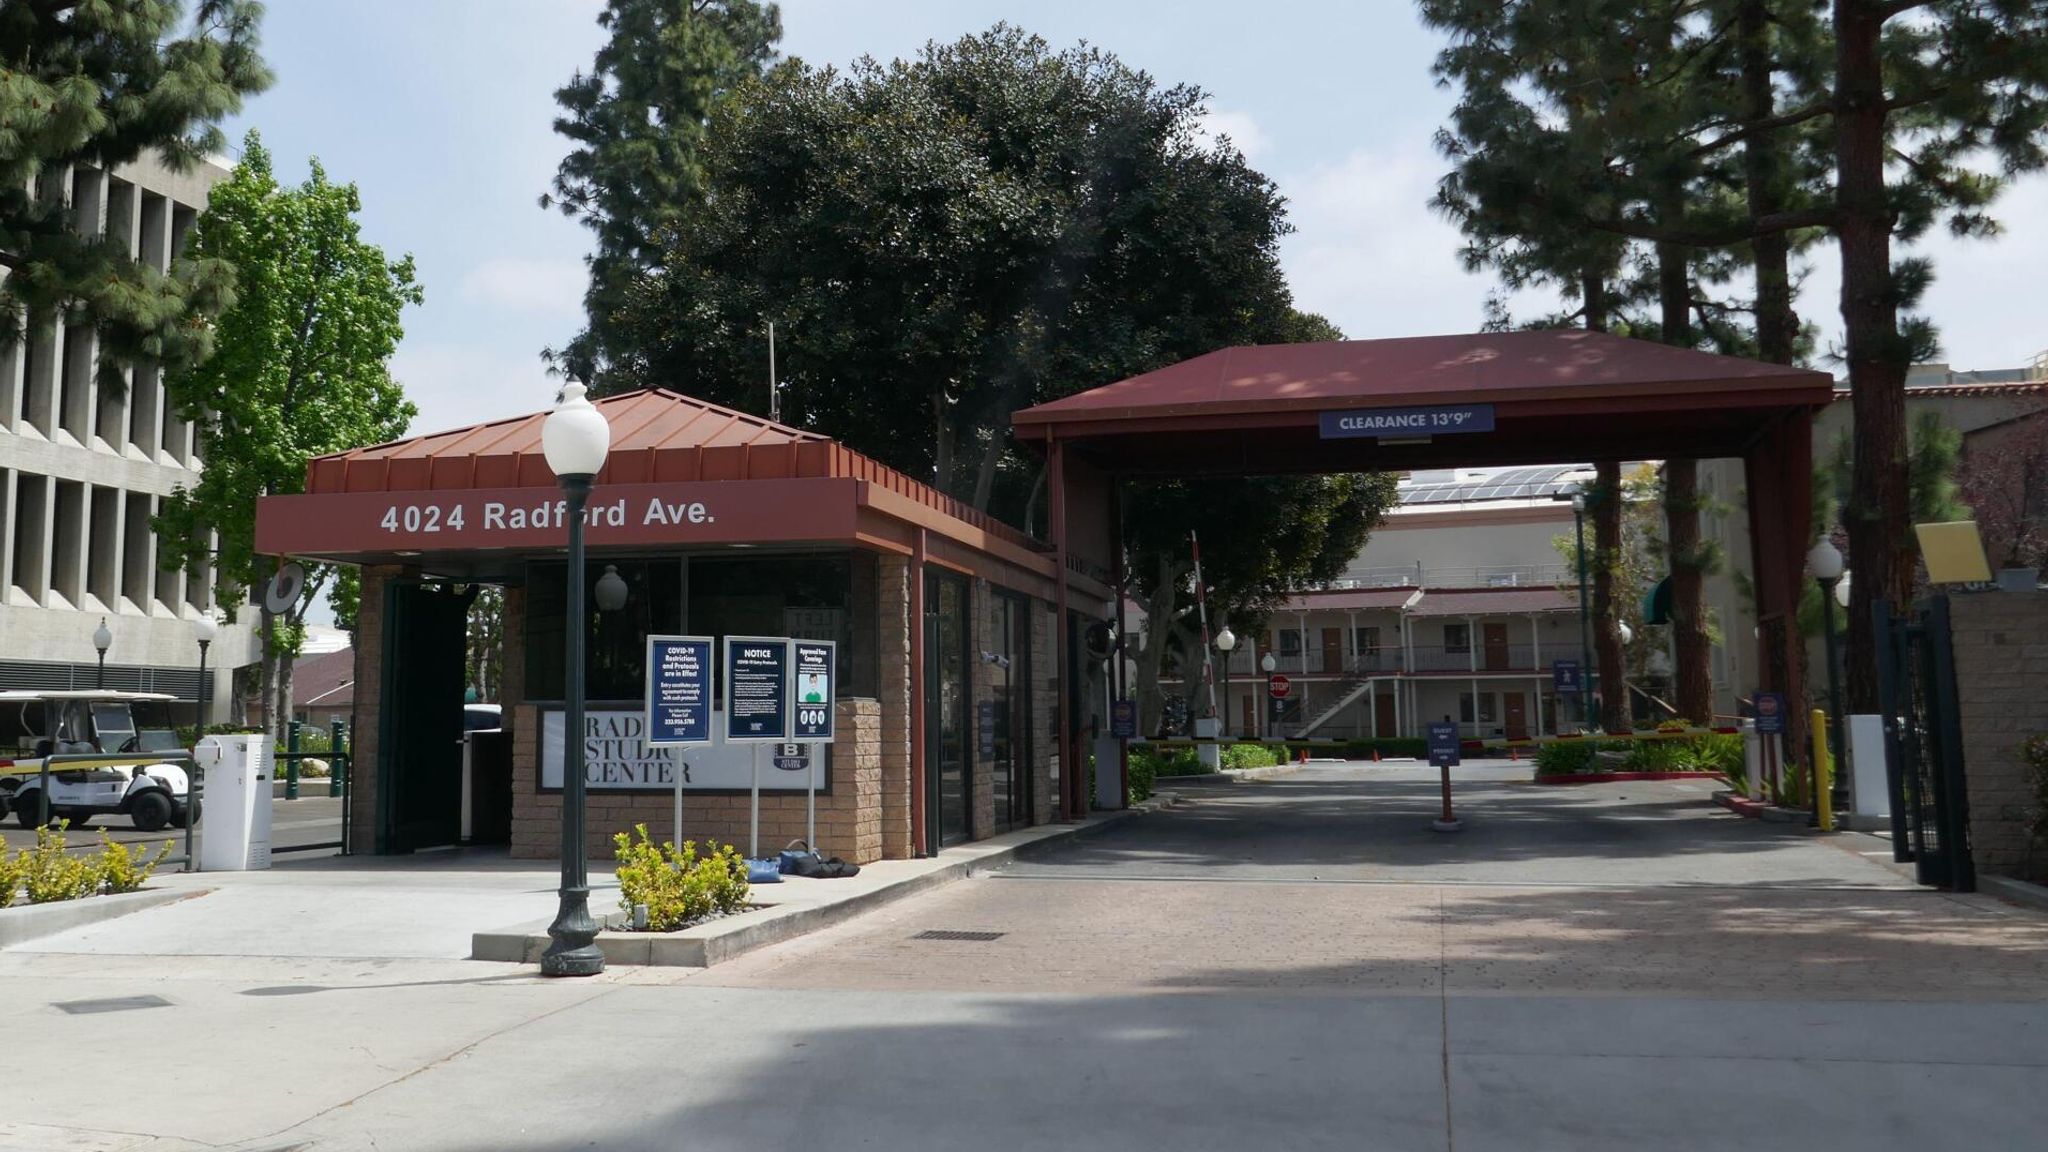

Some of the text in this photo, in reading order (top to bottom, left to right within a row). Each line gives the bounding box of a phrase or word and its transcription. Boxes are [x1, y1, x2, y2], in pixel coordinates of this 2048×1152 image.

[1339, 415, 1426, 430] CLEARANCE
[380, 497, 715, 533] 4024 Radfrd Ave.
[744, 649, 771, 658] NOTICE
[674, 662, 700, 670] Protocols
[1270, 682, 1289, 691] STOP
[586, 716, 646, 738] RAD
[784, 743, 798, 756] B
[584, 762, 692, 783] CENTER
